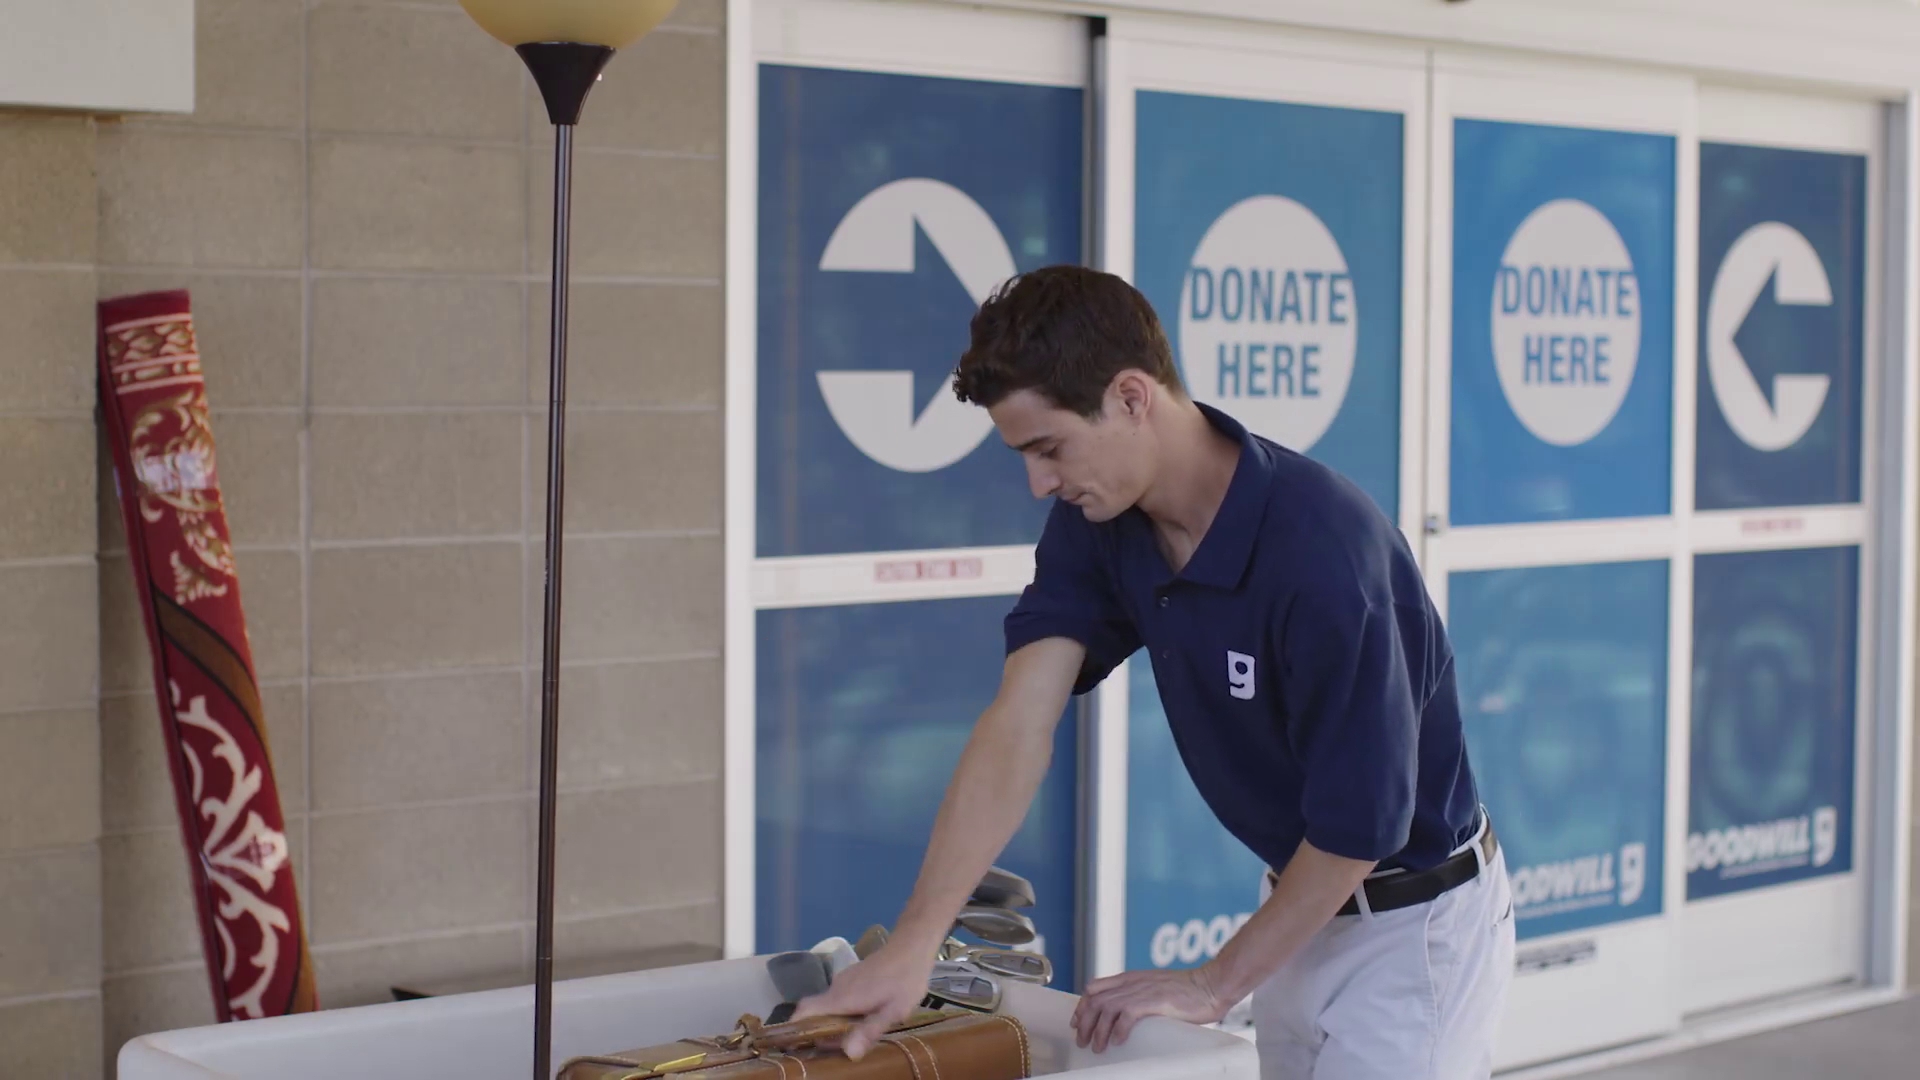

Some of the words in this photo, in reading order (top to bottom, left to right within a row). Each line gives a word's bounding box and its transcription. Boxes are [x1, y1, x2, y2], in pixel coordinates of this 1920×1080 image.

[1189, 267, 1351, 324] DONATE
[1500, 266, 1636, 319] DONATE
[1217, 343, 1321, 398] HERE
[1523, 335, 1611, 385] HERE
[1685, 815, 1810, 873] GOODWILL
[1510, 852, 1616, 907] ODWILL
